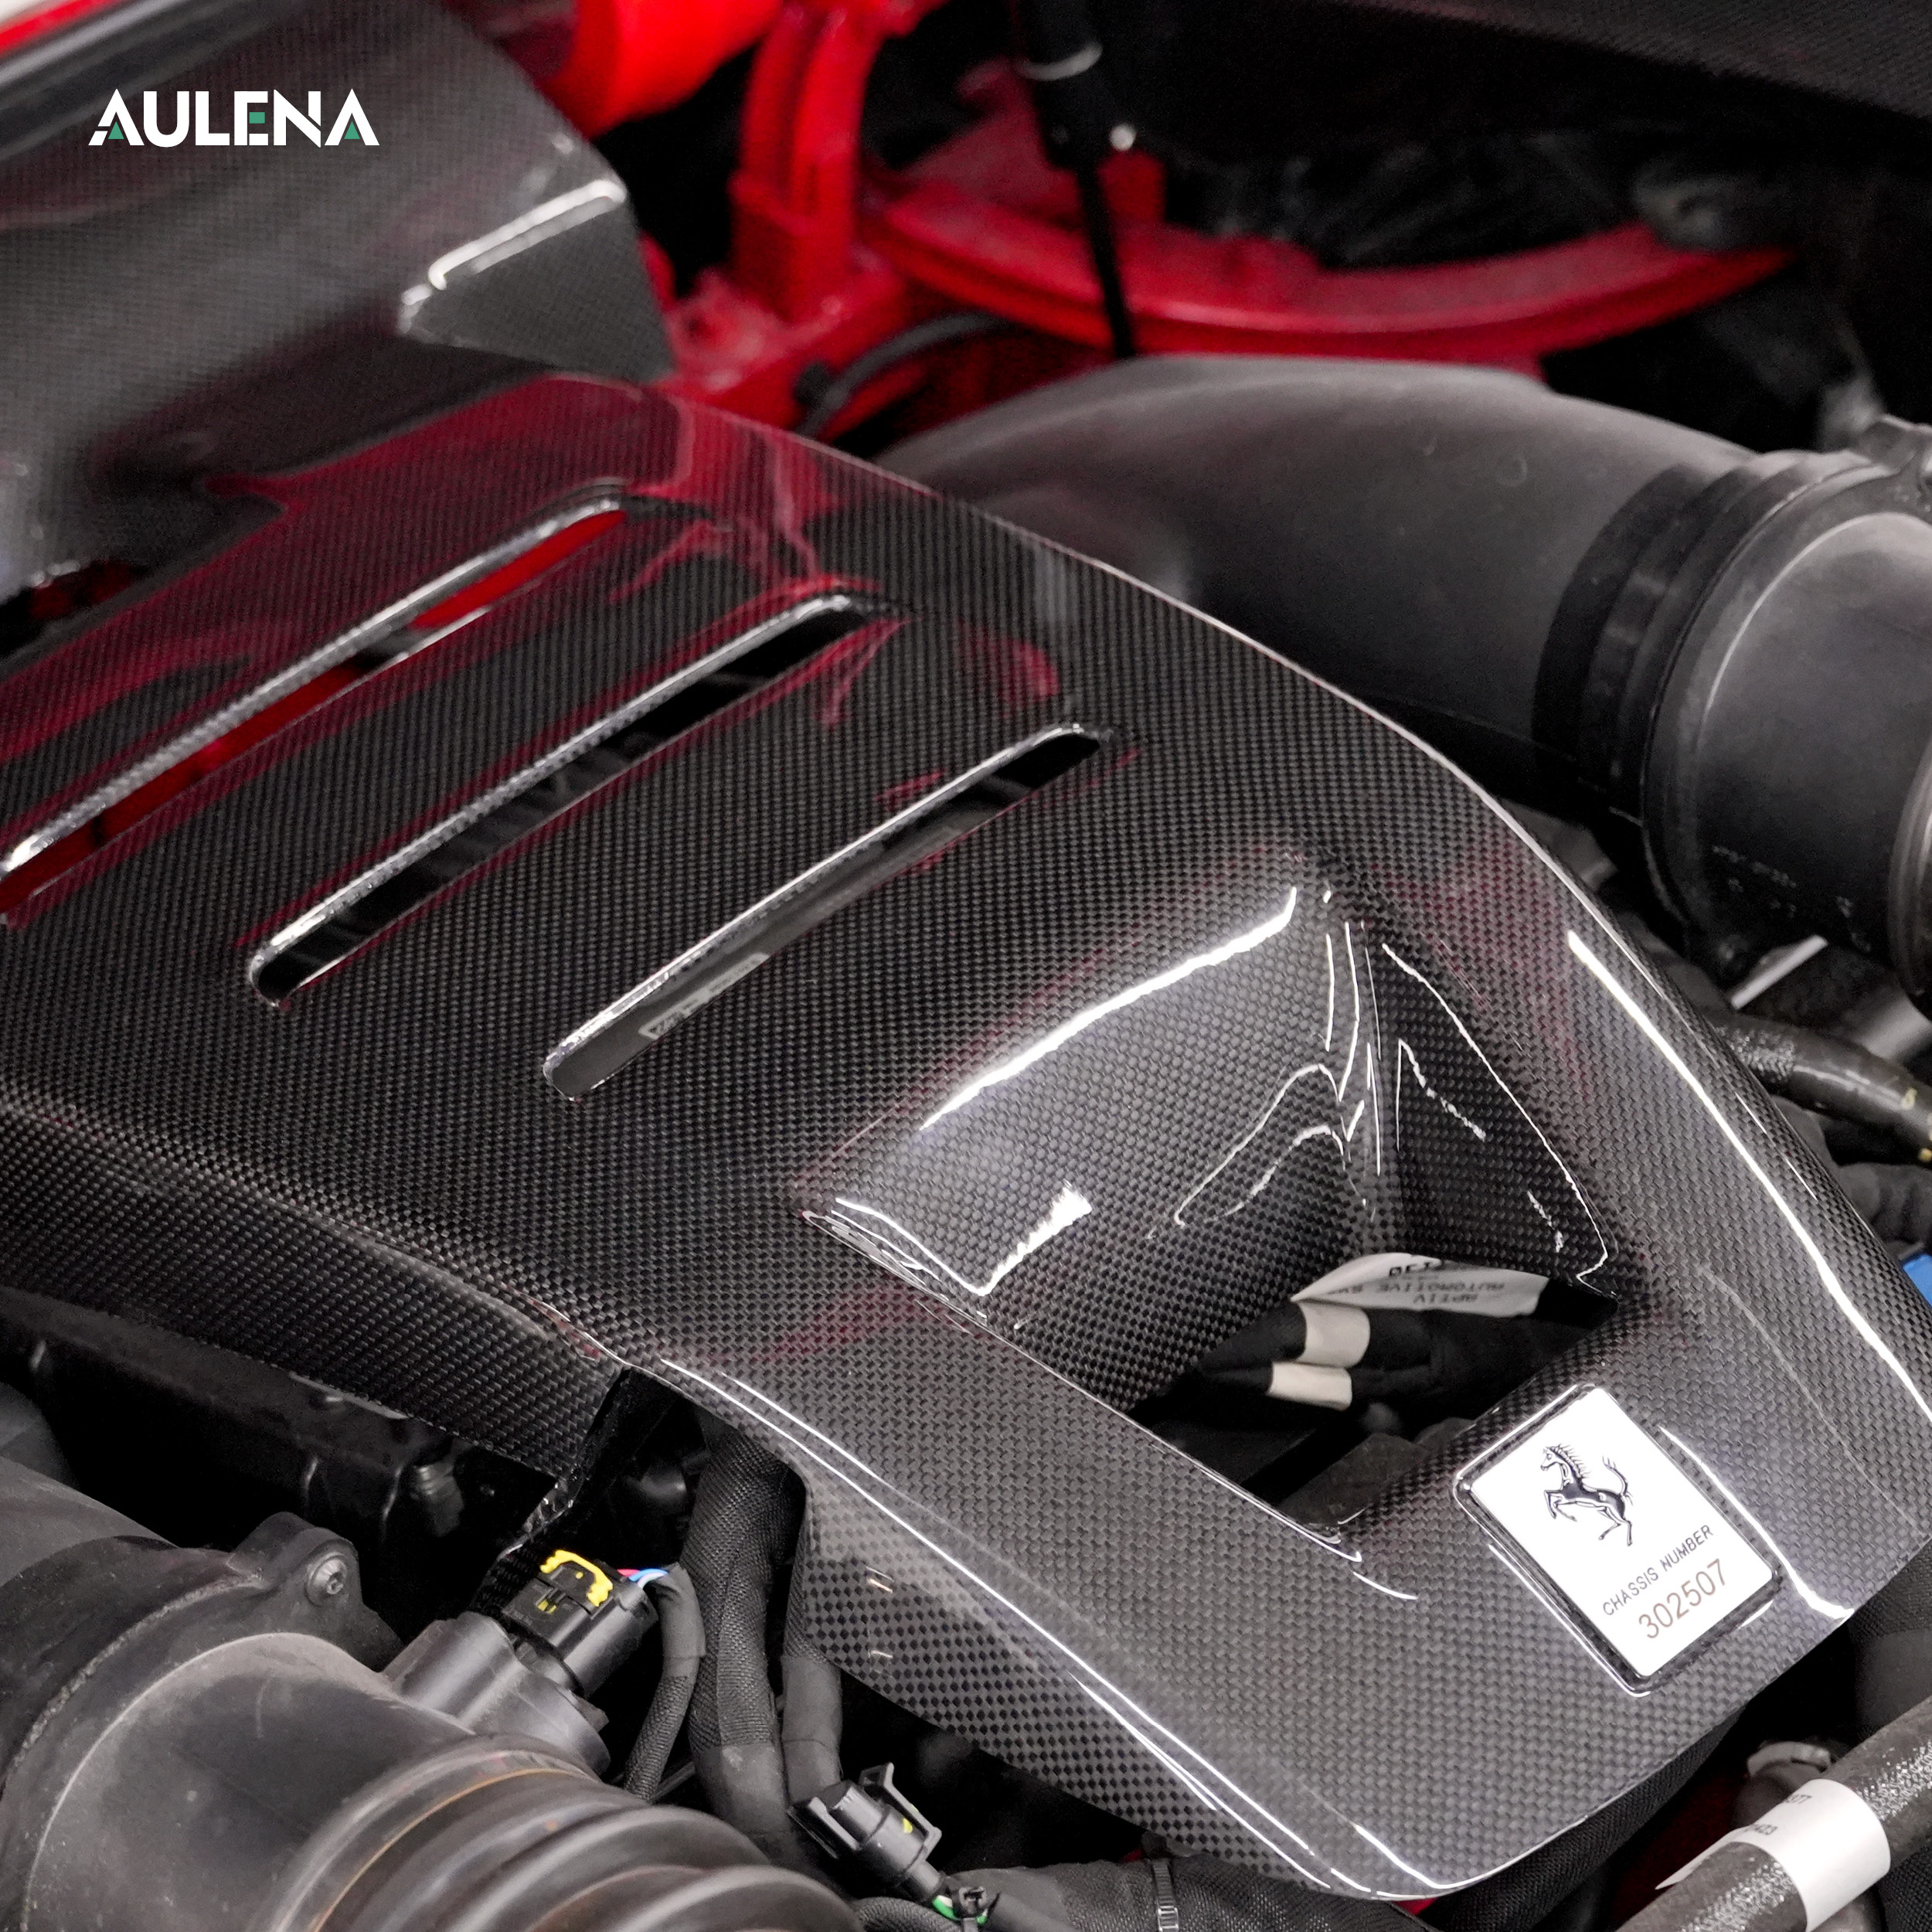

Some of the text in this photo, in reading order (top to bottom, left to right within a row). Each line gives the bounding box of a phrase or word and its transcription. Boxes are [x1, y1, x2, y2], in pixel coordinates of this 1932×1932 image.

[1603, 1525, 1713, 1615] CHASSIS NUMBER
[1638, 1558, 1725, 1638] 302507
